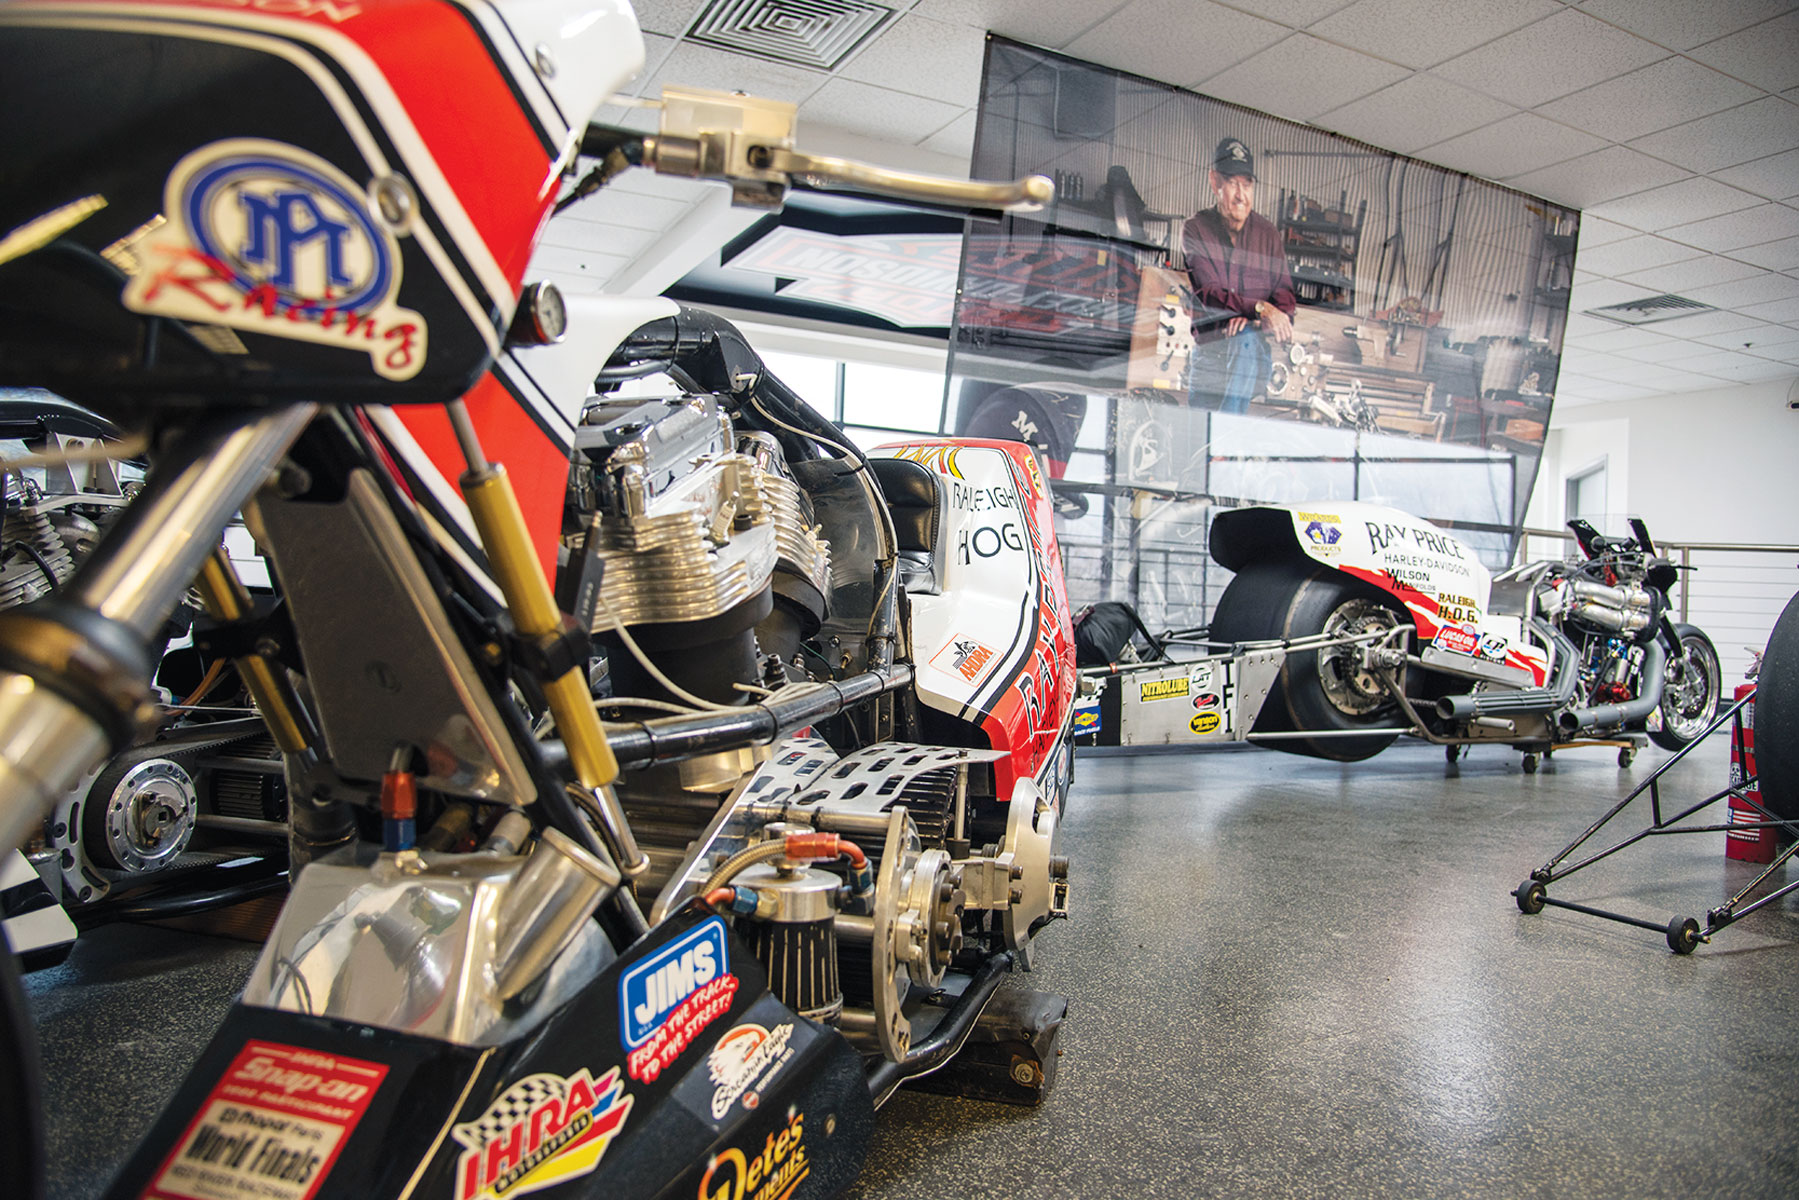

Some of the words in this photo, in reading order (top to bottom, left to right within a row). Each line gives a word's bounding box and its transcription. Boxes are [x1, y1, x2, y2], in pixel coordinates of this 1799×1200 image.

[953, 482, 1019, 512] RALEIGH
[958, 523, 1024, 565] HOG
[1366, 522, 1406, 554] RAY
[1412, 529, 1464, 560] PRICE
[1384, 553, 1470, 576] HARLEY-DAVIDSON
[1386, 567, 1430, 582] WILSON
[1438, 593, 1476, 608] RALEIGH
[1438, 605, 1478, 623] H.O.G.
[1440, 629, 1463, 643] LUCAS
[1463, 636, 1475, 646] OIL
[959, 645, 993, 681] AHDRA
[1142, 677, 1188, 696] NITROLUBE
[634, 940, 716, 1025] JIMS
[631, 1028, 668, 1075] FROM
[667, 1003, 690, 1032] THE
[641, 1058, 661, 1081] TO
[660, 1032, 685, 1062] THE
[684, 992, 732, 1039] STREET!
[234, 1056, 369, 1103] Snap-on
[185, 1124, 259, 1169] World
[249, 1137, 321, 1185] Finals
[463, 1078, 596, 1200] IHRA
